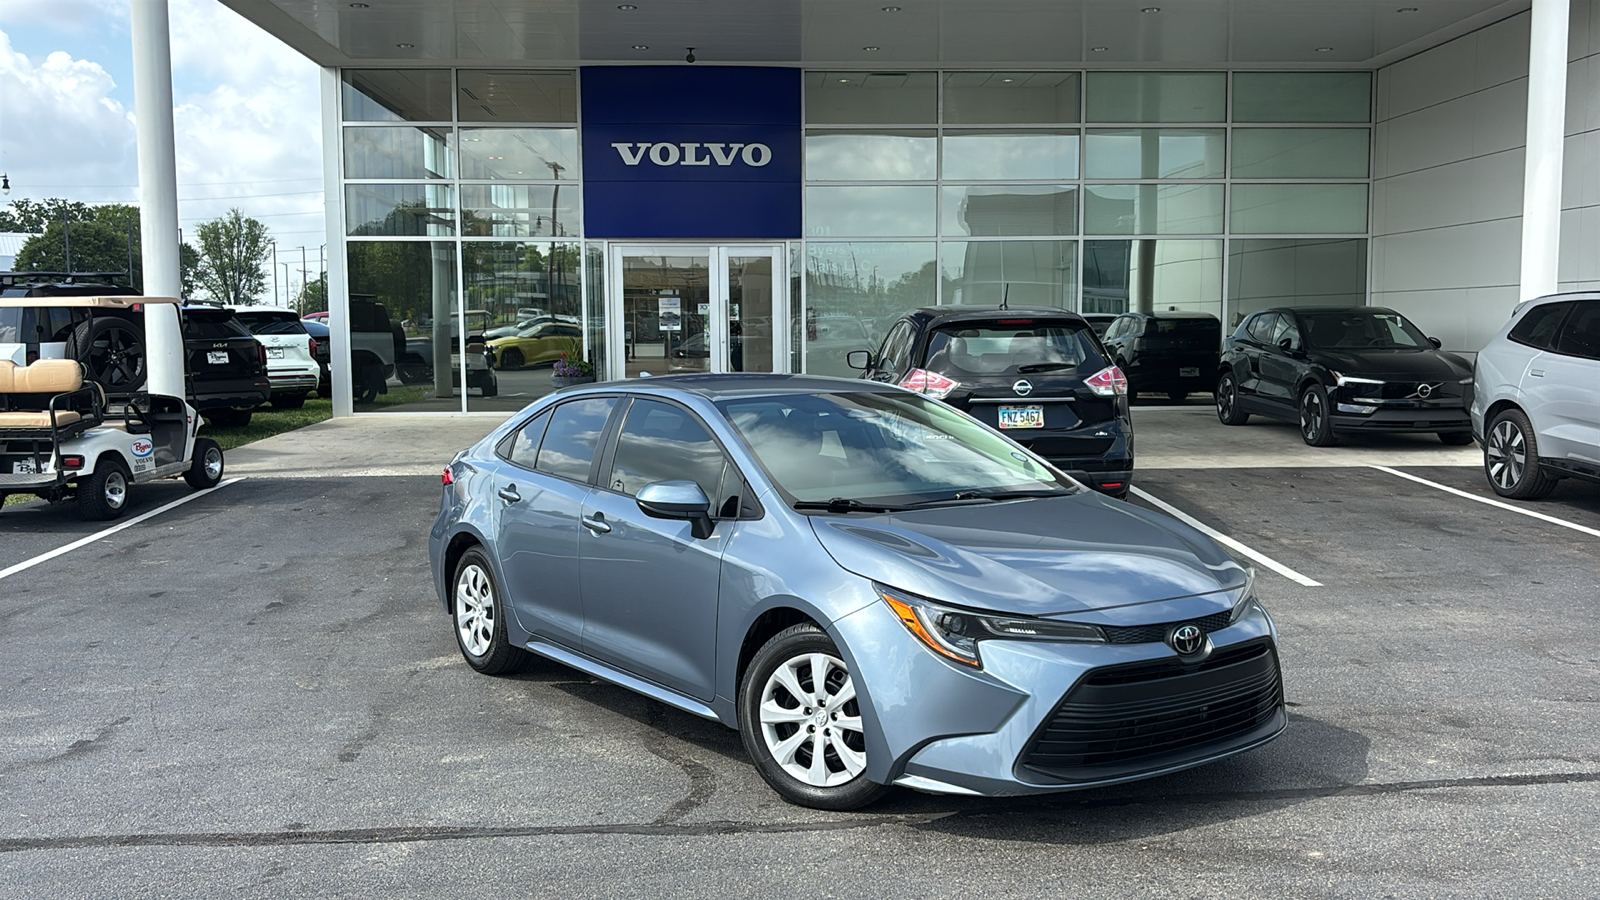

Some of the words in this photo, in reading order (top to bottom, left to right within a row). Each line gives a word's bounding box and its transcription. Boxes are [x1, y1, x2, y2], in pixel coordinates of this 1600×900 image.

[611, 142, 772, 167] VOLVO
[808, 245, 846, 257] Byers
[1002, 411, 1018, 423] FNZ
[1020, 411, 1040, 423] 5467
[133, 442, 151, 453] Byers
